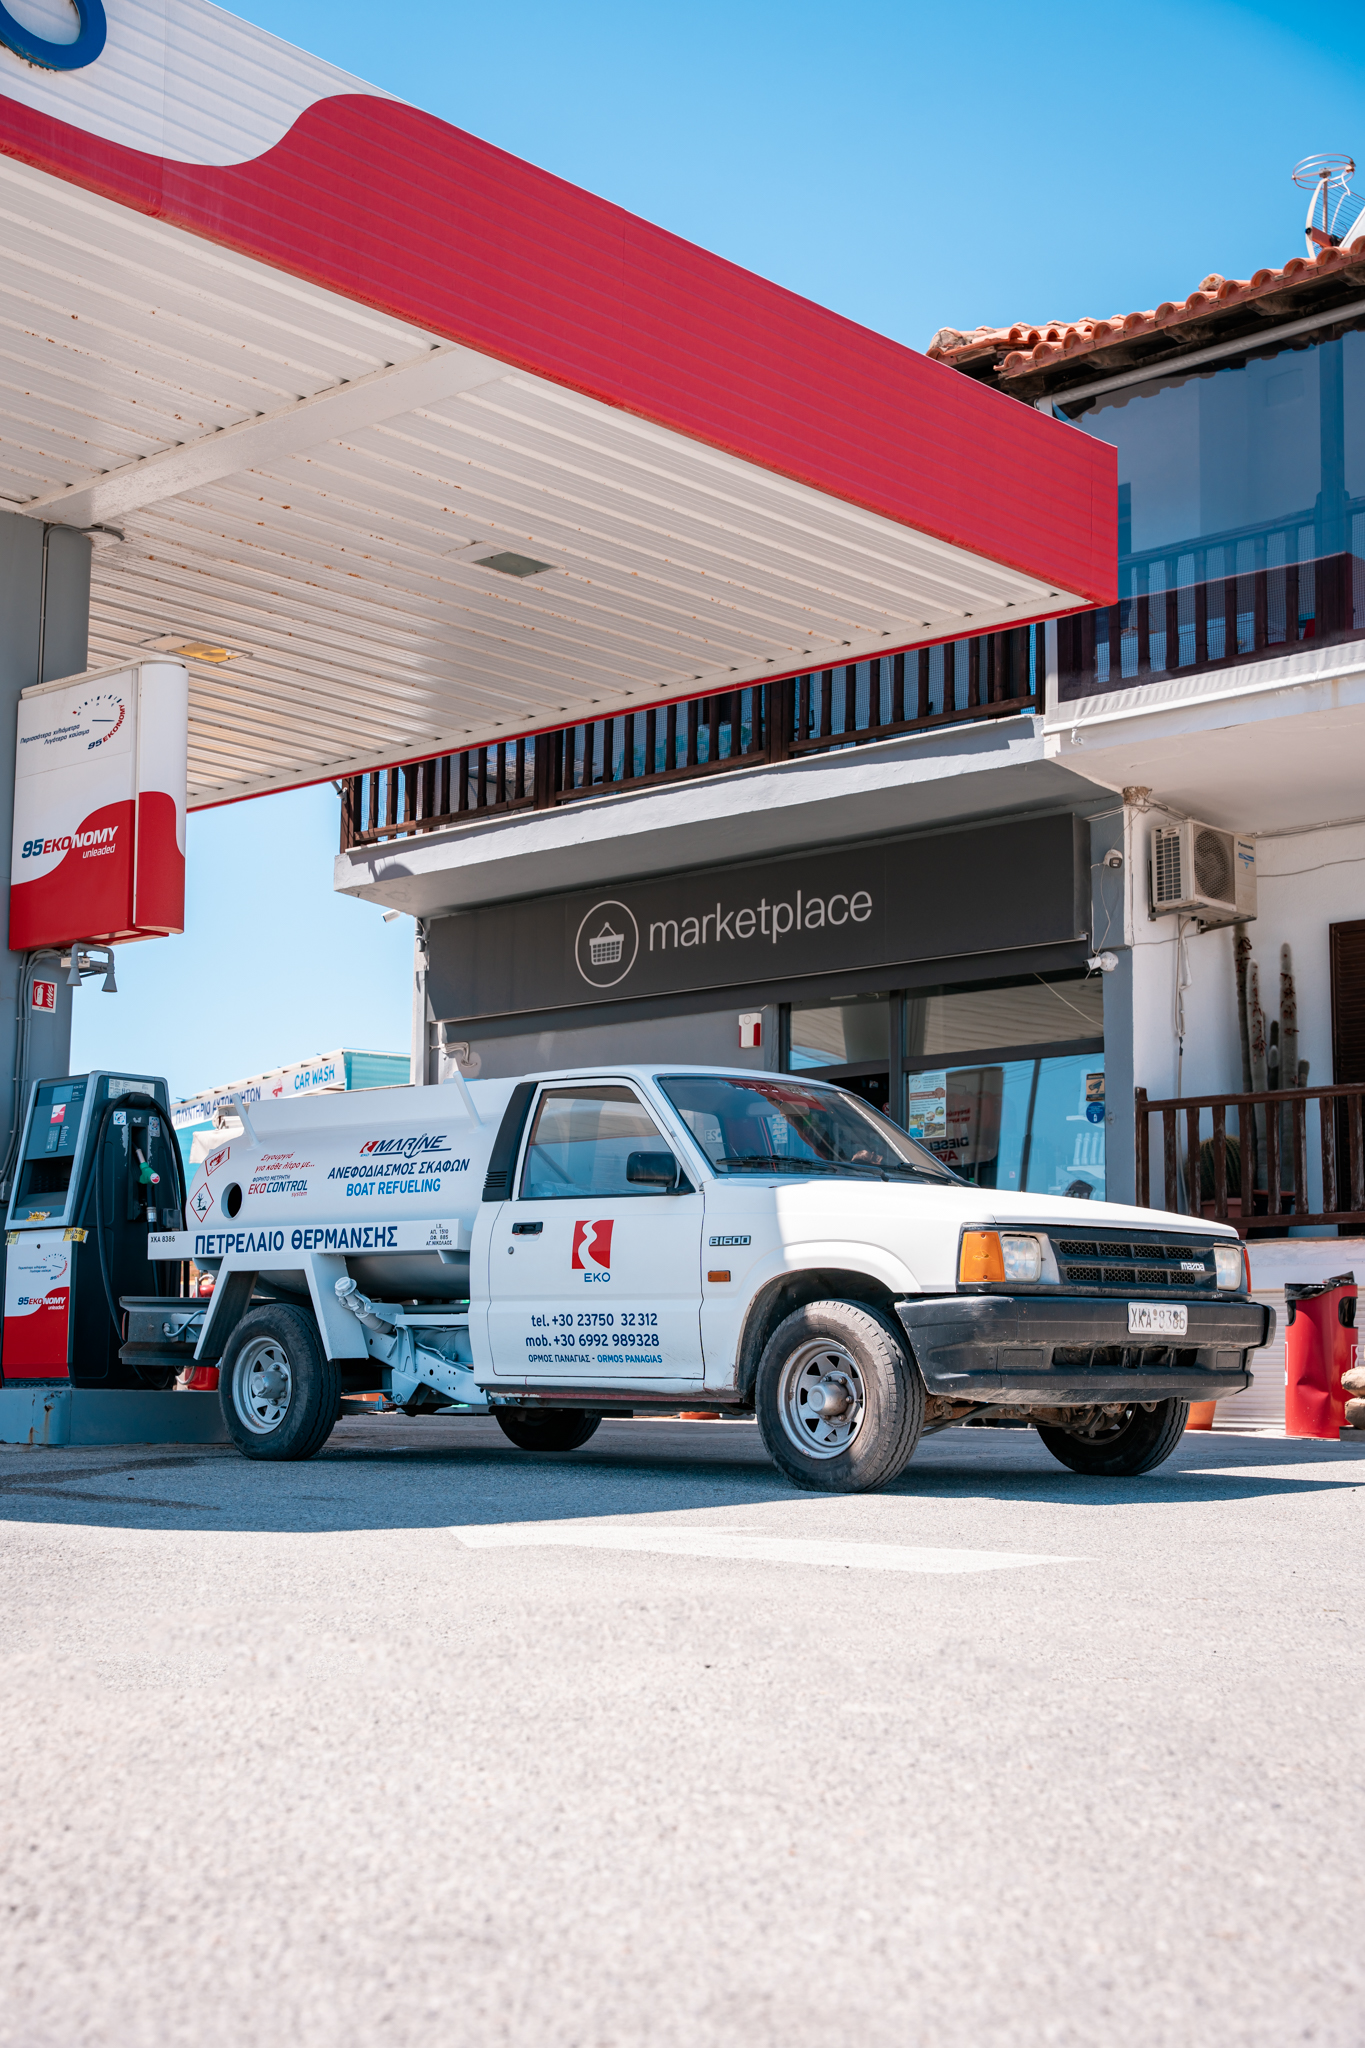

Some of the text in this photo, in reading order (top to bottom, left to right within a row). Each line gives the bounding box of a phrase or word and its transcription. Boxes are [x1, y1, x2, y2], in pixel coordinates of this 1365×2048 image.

[82, 843, 116, 859] unleaded
[649, 889, 873, 951] marketplace
[294, 1064, 335, 1090] CAR WASH
[373, 1134, 449, 1156] MARINE
[327, 1158, 471, 1180] ΑΝΕΦΟΔΙΑΣΜΟΣ ΣΚΑΦΩΝ
[248, 1180, 308, 1195] EKO CONTROL
[346, 1178, 441, 1197] BOAT REFUELING
[195, 1226, 398, 1255] ΠΕΤΡΕΛΑΙΟ ΘΕΡΜΑΝΣΗΣ
[584, 1272, 611, 1283] EKO
[531, 1314, 550, 1326] tel.
[552, 1314, 573, 1326] +30
[577, 1313, 614, 1326] 23750
[525, 1334, 660, 1347] mob. +30 6992 989328
[528, 1354, 553, 1363] ΟΡΜΟΣ
[555, 1354, 590, 1363] ΠΑΝΑΓΙΑΣ
[597, 1354, 624, 1363] ORMOS
[625, 1354, 663, 1364] PANAGIAS
